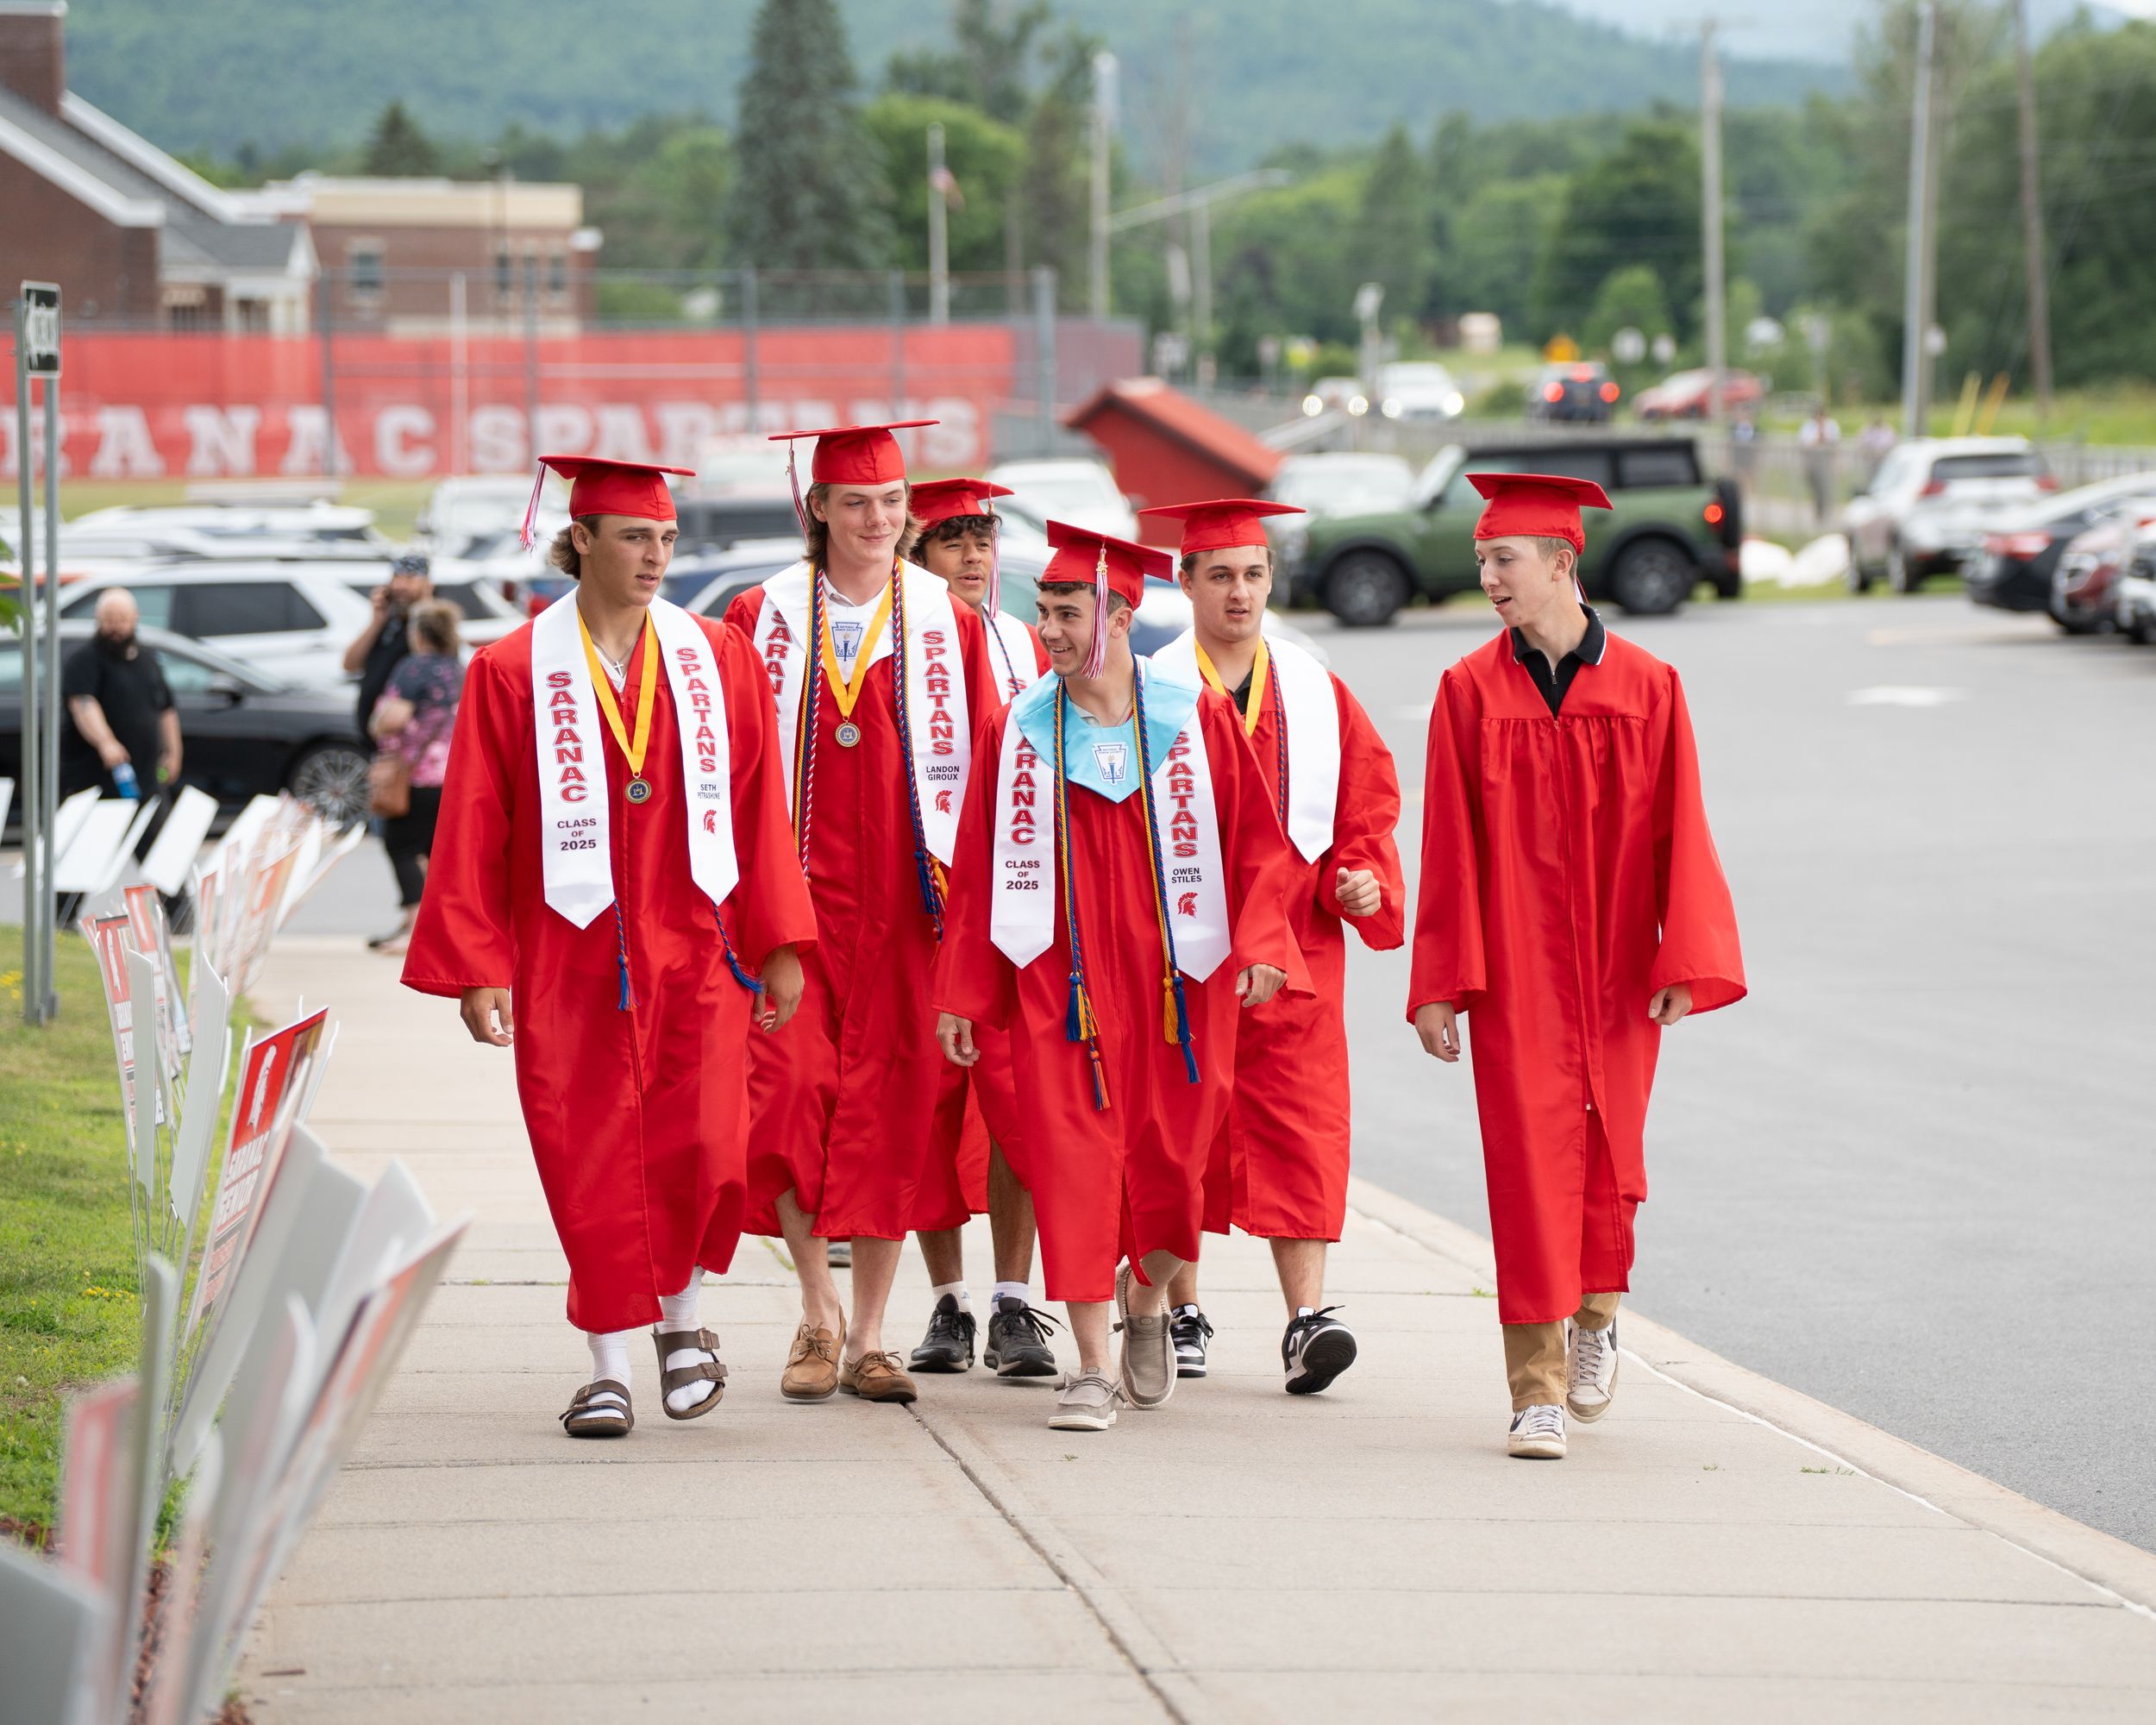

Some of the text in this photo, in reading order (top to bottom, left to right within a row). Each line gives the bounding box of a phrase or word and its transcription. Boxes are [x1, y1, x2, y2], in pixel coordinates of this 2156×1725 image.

[468, 398, 982, 476] SPARS
[764, 609, 793, 728] SARA
[922, 630, 955, 756] SPARTANS
[546, 670, 589, 803] SARANAC
[675, 648, 717, 774] SPARTANS
[557, 819, 597, 829] CLASS
[1010, 730, 1038, 846] ARANAC
[561, 839, 597, 851] 2025
[1171, 875, 1202, 884] STILES
[1173, 867, 1200, 875] OWEN
[1006, 881, 1038, 890] 2025
